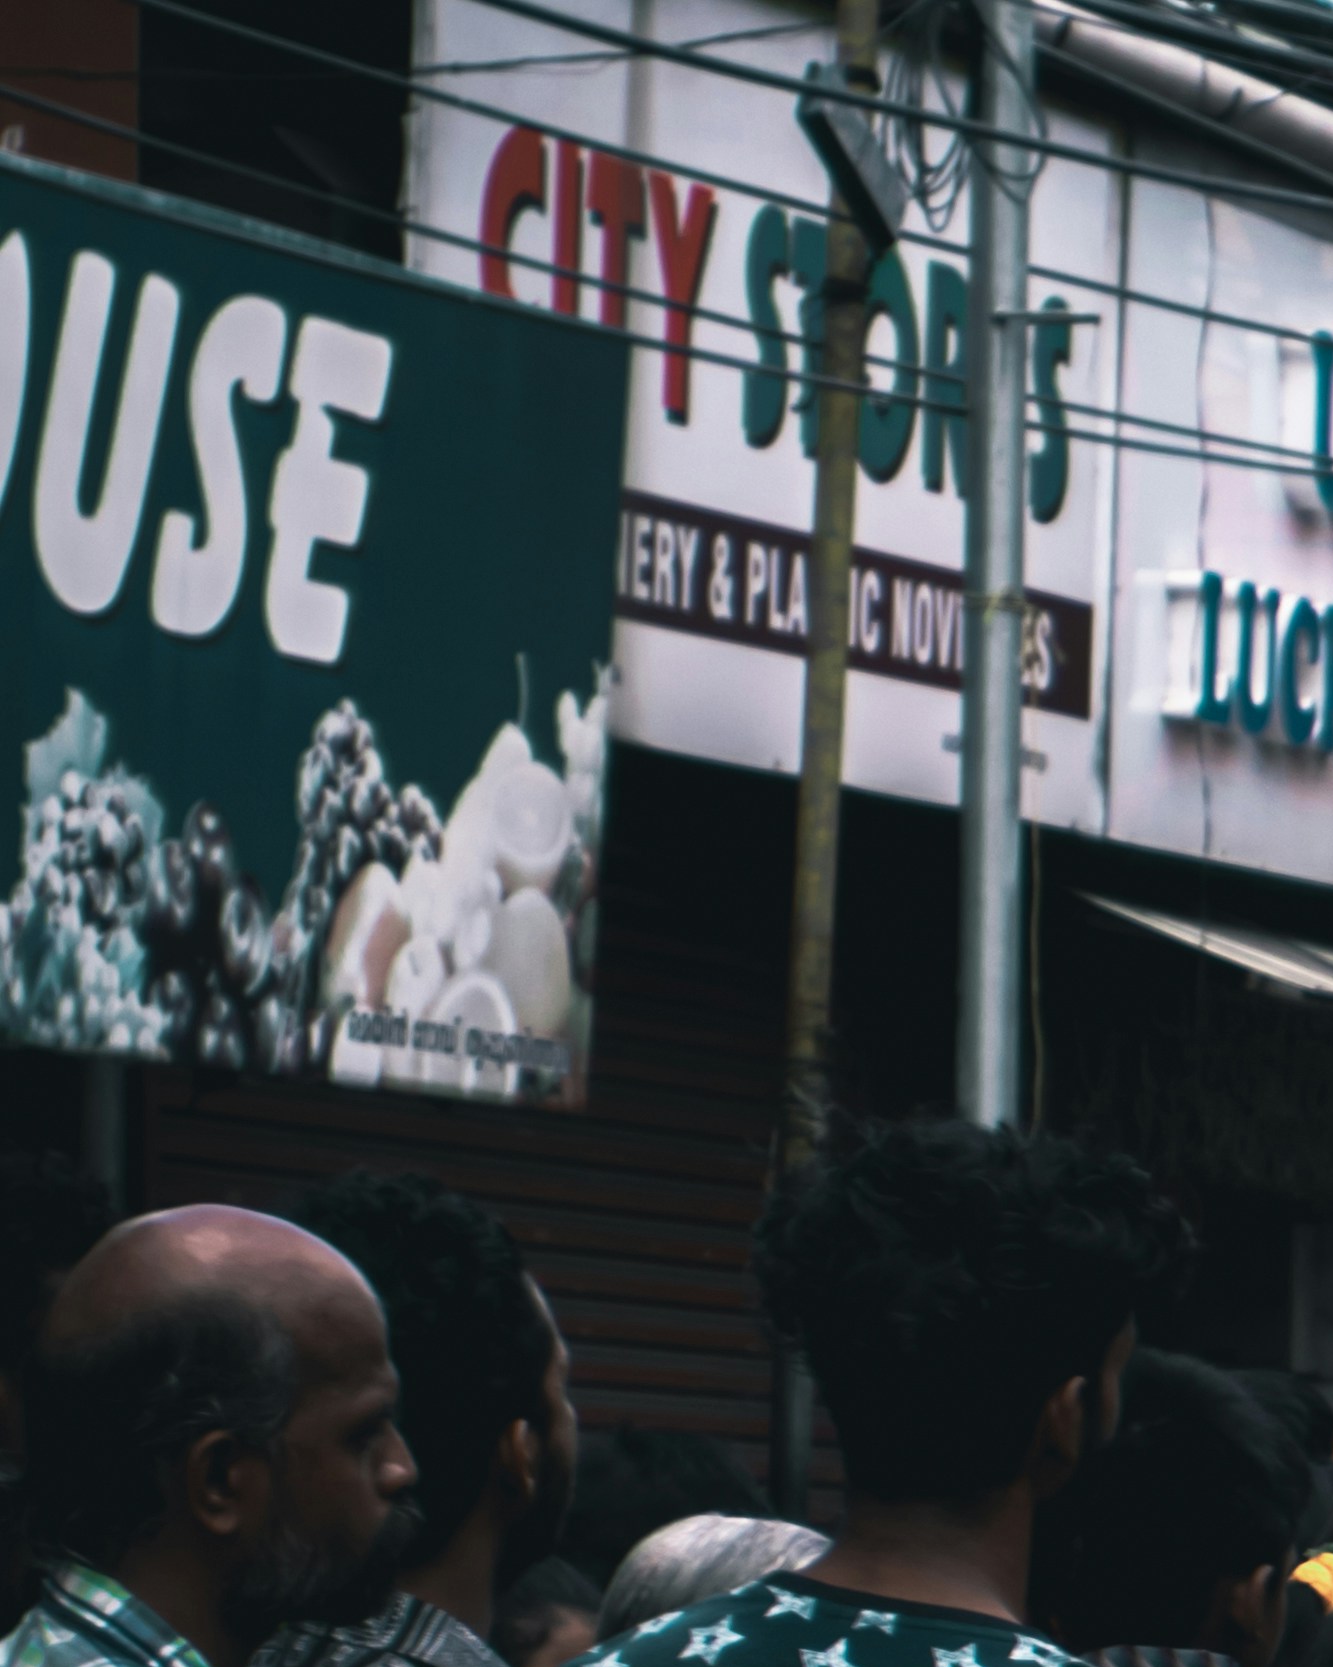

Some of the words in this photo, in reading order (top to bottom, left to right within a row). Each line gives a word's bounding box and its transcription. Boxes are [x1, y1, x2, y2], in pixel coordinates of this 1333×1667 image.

[0, 228, 394, 666] USE
[478, 123, 718, 426] CITY
[742, 200, 1073, 525] STORS
[708, 532, 734, 621] &
[744, 540, 882, 654] PLAIC
